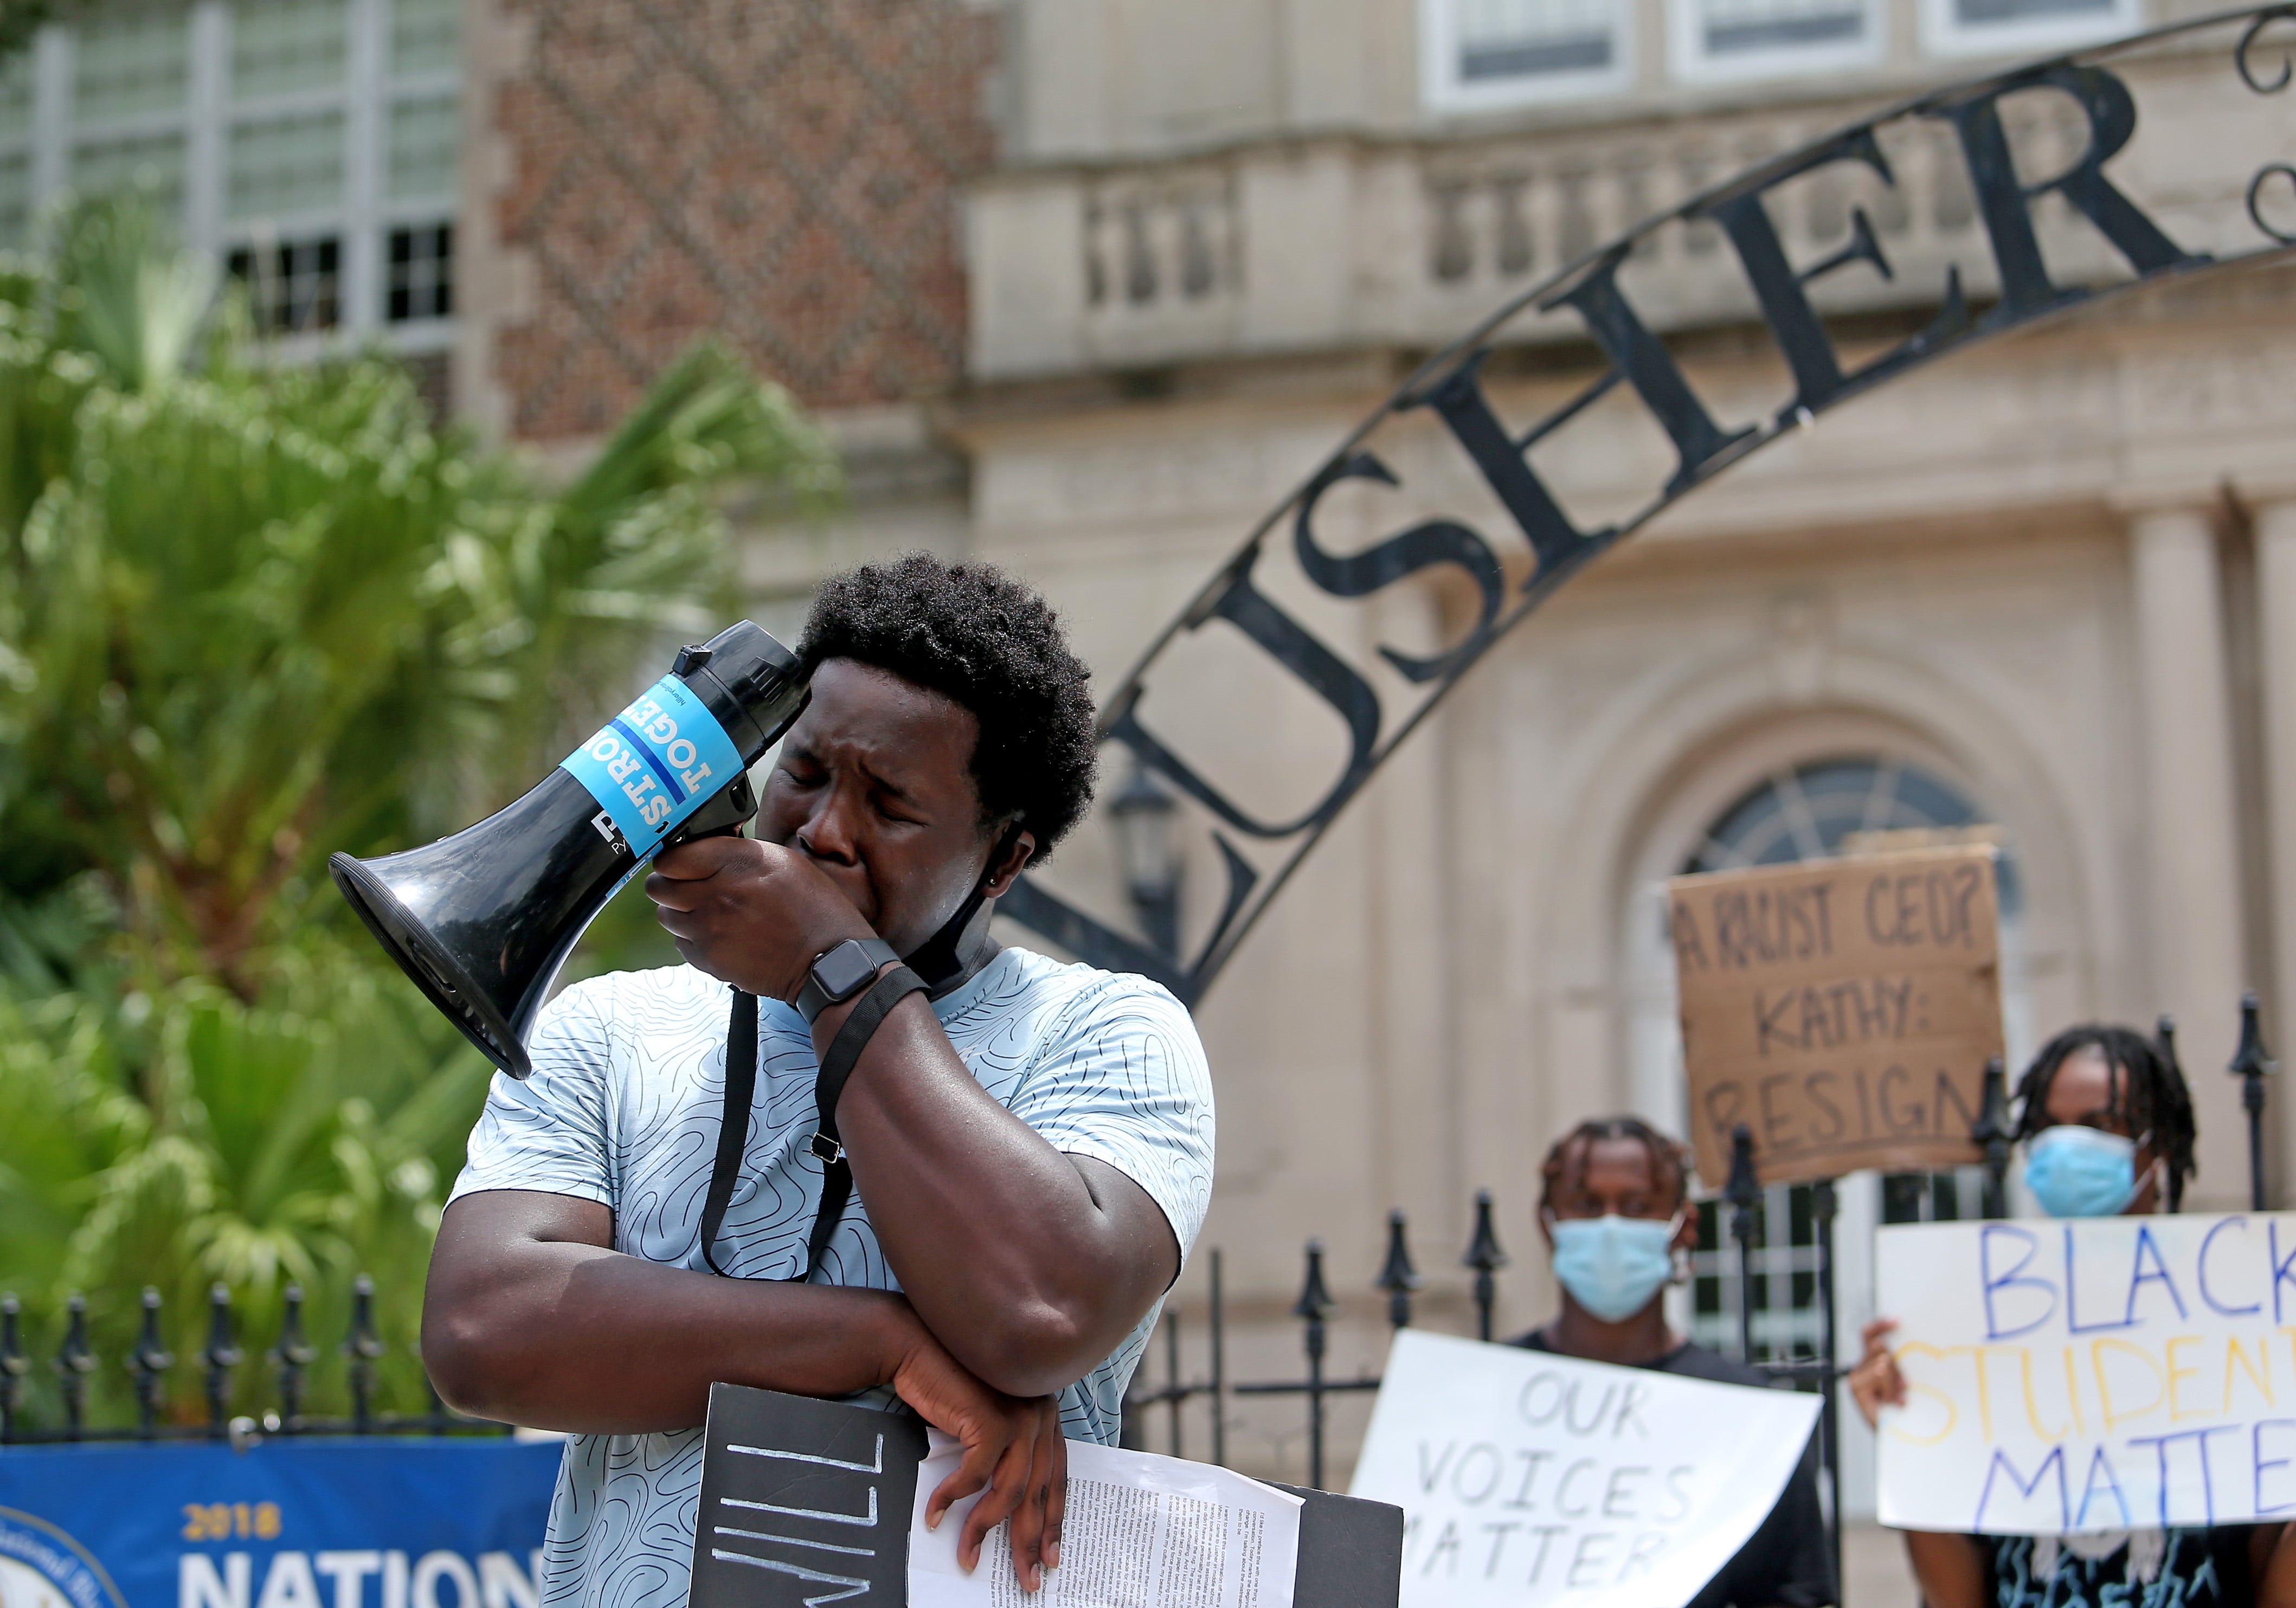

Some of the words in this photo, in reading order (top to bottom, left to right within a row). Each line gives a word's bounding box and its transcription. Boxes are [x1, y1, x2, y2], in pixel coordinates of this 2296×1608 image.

[993, 59, 2215, 1009] LUSHER
[1672, 899, 1709, 972] A
[1864, 863, 1983, 950] CEO?
[1752, 979, 1931, 1056] KATHY:
[1704, 1064, 1976, 1160] RESIGN
[1517, 1371, 1654, 1440] OUR
[1417, 1439, 1697, 1523] VOICES
[181, 1502, 281, 1540] 2018
[1208, 1533, 1212, 1541] me
[1088, 1558, 1094, 1566] my
[1163, 1540, 1168, 1548] my
[1184, 1528, 1192, 1558] suffocating.
[1405, 1518, 1671, 1587] ATTER
[178, 1549, 544, 1608] NATION
[1159, 1569, 1165, 1578] my
[1165, 1566, 1173, 1593] pressuring
[1155, 1599, 1161, 1607] my
[1165, 1594, 1169, 1603] me
